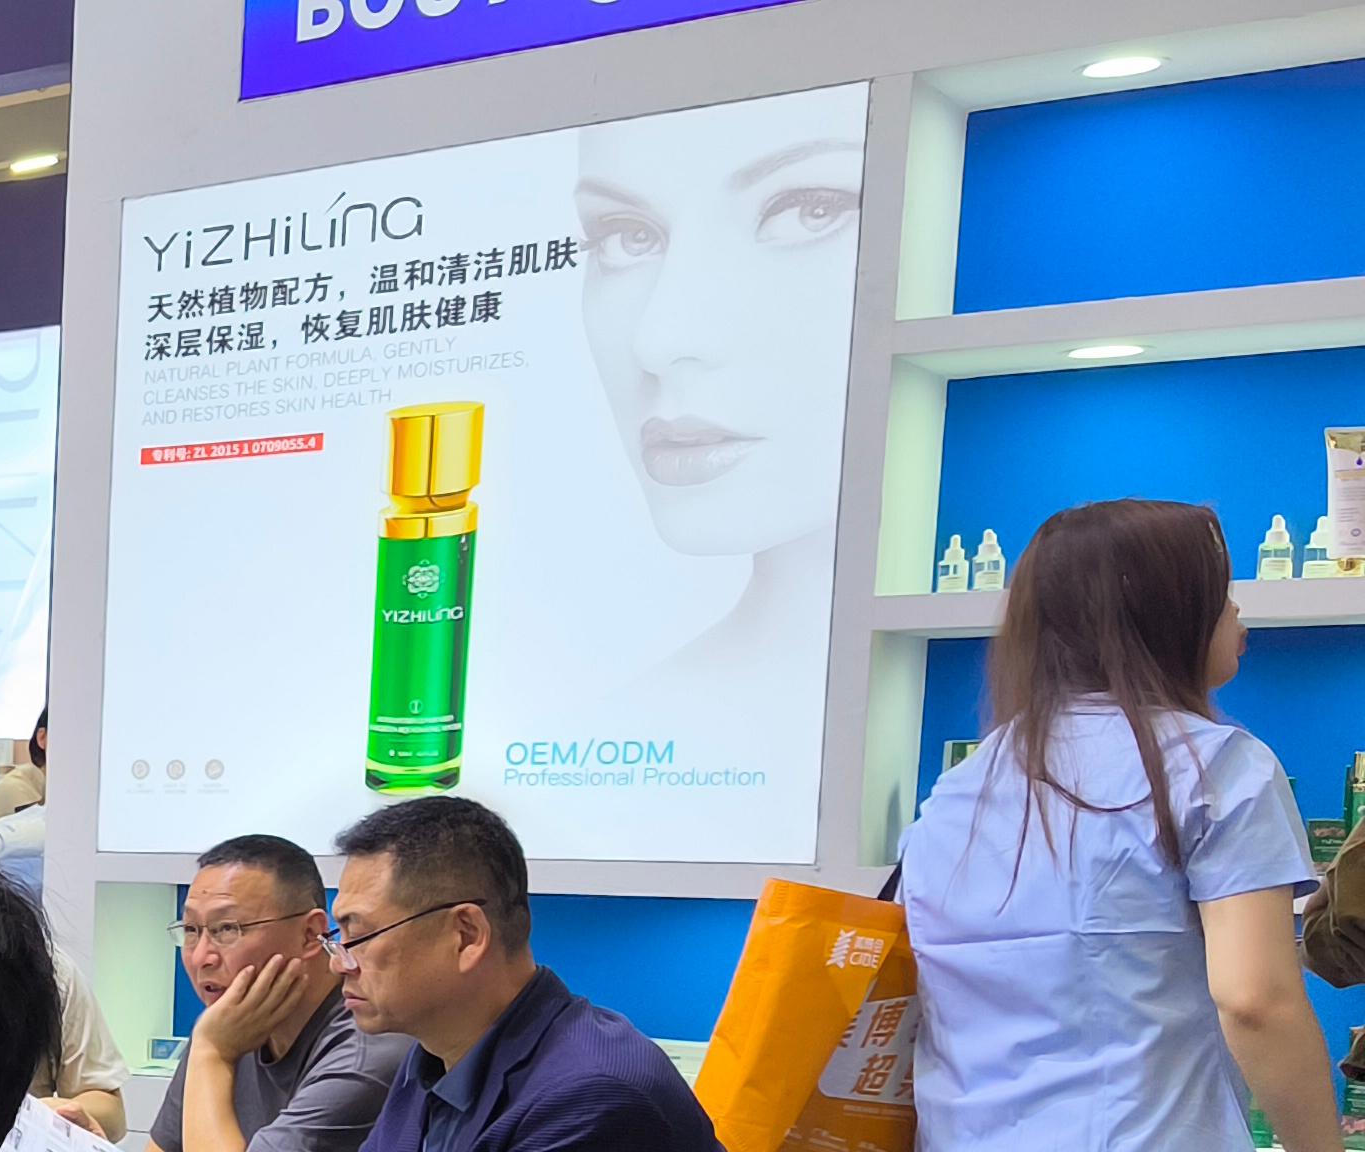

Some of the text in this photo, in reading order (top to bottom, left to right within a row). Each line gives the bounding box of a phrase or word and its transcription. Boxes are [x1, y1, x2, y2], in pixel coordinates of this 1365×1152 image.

[143, 365, 222, 386] NATURAL
[226, 357, 280, 378] PLANT
[382, 336, 459, 360] GENTLY
[143, 384, 230, 407] CLEANSES
[235, 377, 268, 399] THE
[324, 366, 393, 390] DEEPLY
[141, 387, 393, 427] AND RESTORES SKIN HEALTH
[210, 442, 240, 459] 2015
[504, 738, 676, 768] OEM/ODM
[503, 765, 767, 789] Professional Production
